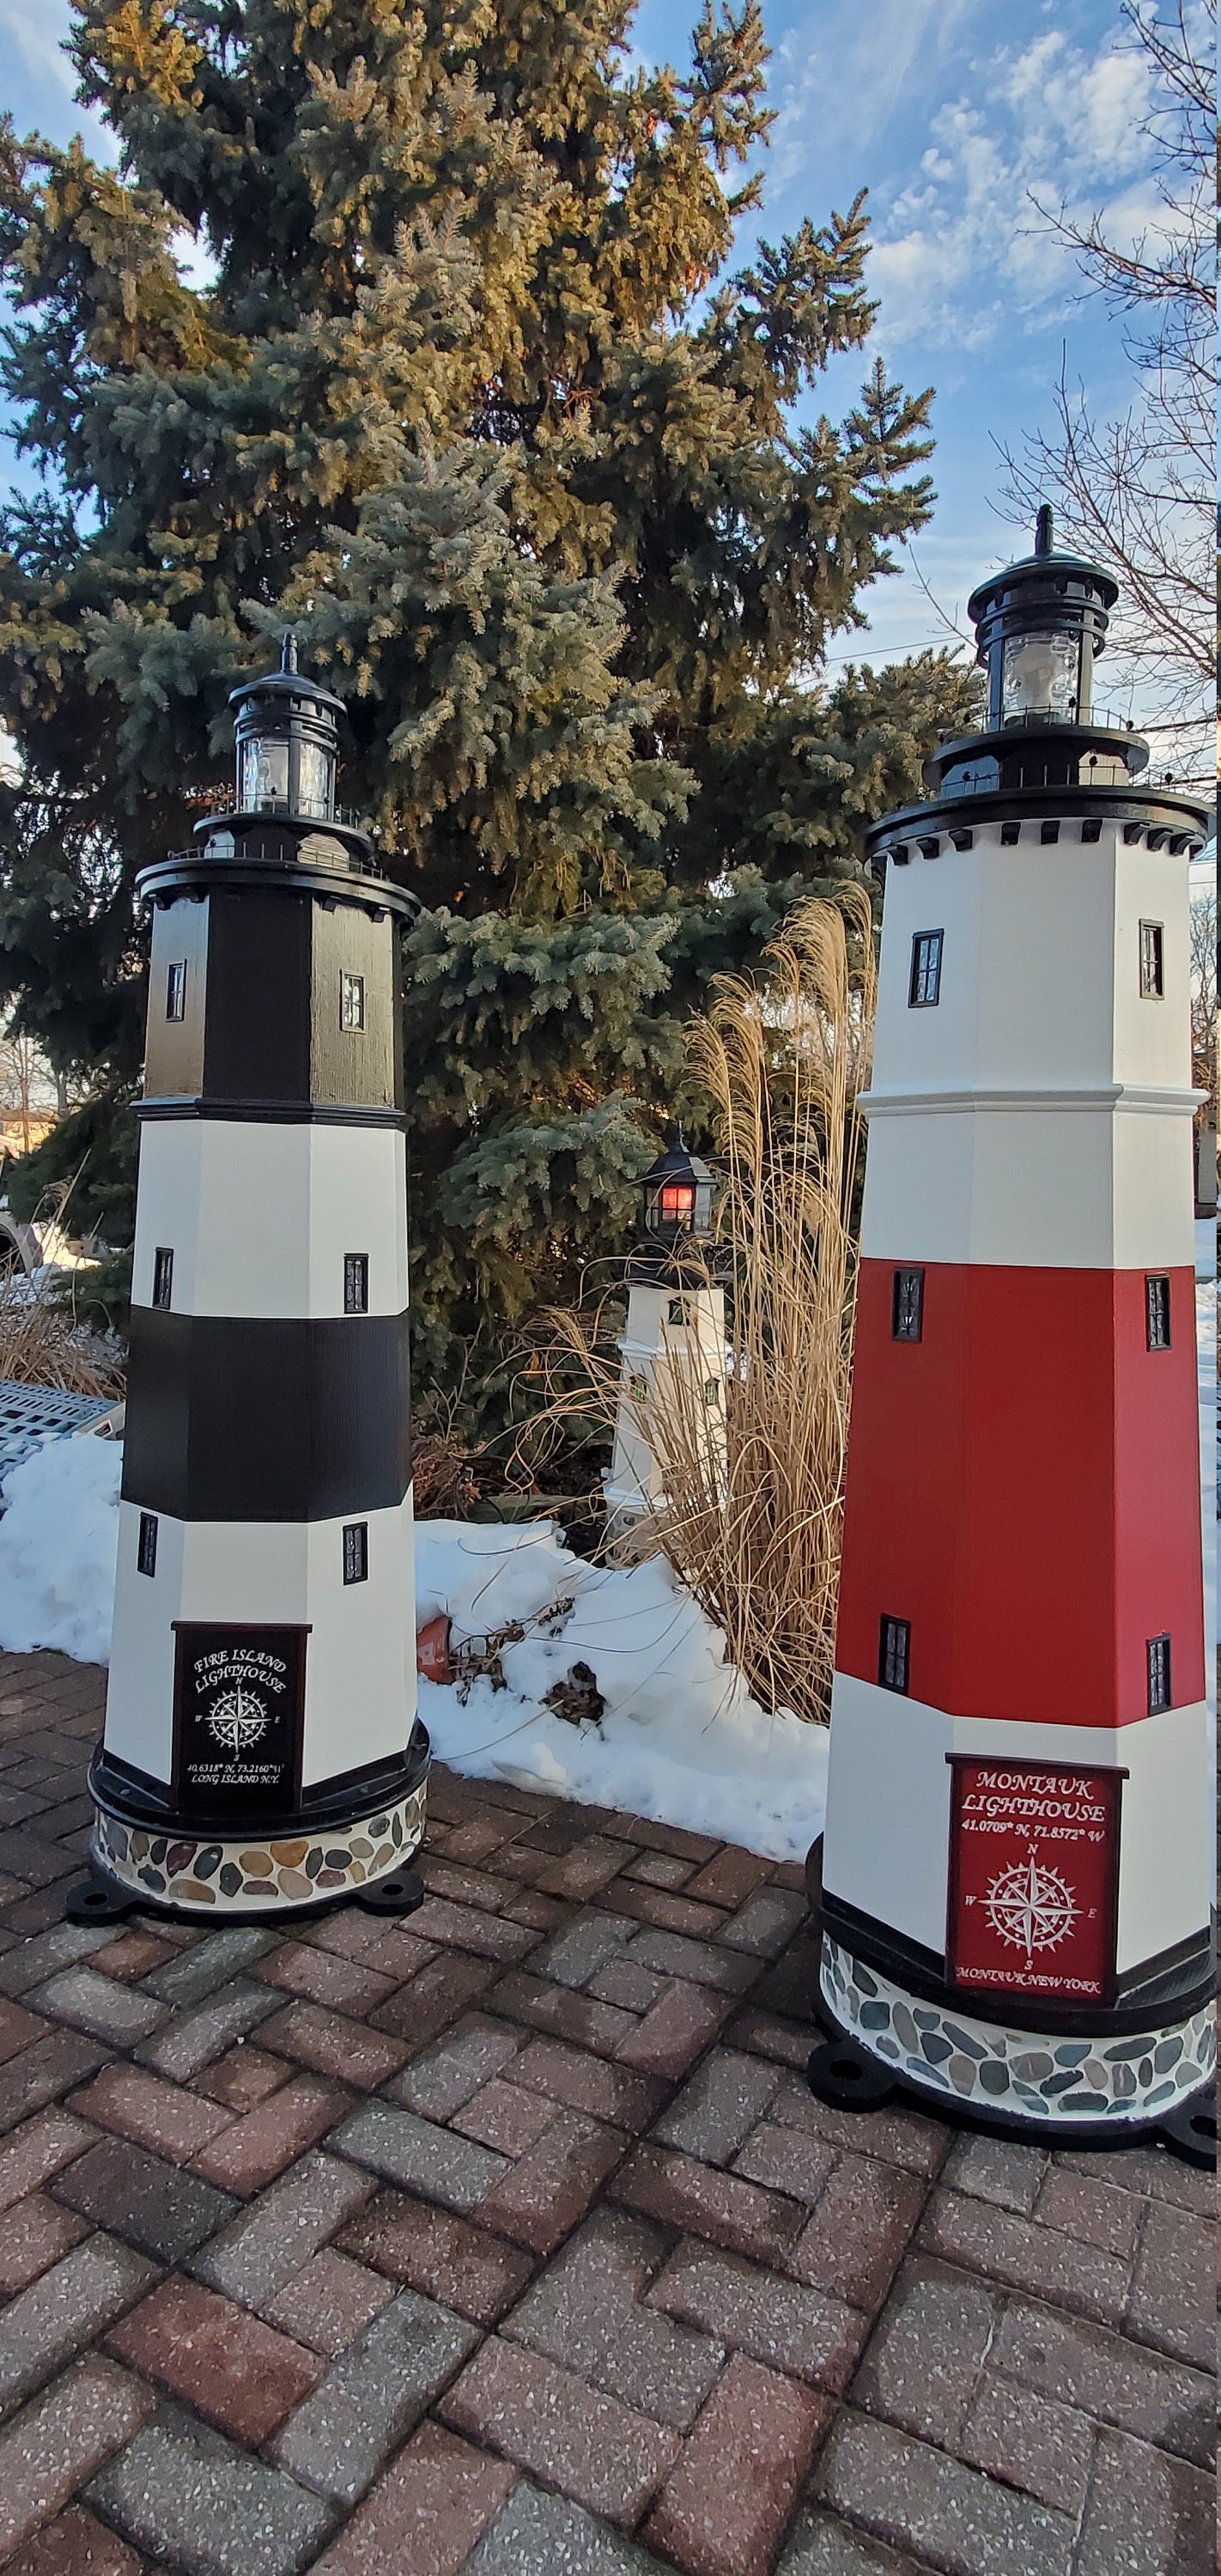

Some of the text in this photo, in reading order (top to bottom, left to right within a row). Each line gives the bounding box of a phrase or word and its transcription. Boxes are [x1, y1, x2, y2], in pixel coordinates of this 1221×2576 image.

[194, 1649, 287, 1673] FIRE ISLAND
[195, 1664, 287, 1694] LIGHTHOUSE
[191, 1774, 281, 1785] LONG ISLAND N.Y.
[975, 1771, 1095, 1800] MONTAUK
[961, 1794, 1106, 1822] LIGHTHOUSE
[1087, 1829, 1105, 1842] W
[1026, 1843, 1039, 1855] N
[964, 1895, 977, 1907] W
[1086, 1908, 1097, 1918] E
[1024, 1959, 1034, 1971] S
[1026, 1974, 1063, 1988] NEW
[1063, 1978, 1102, 1994] YORK
